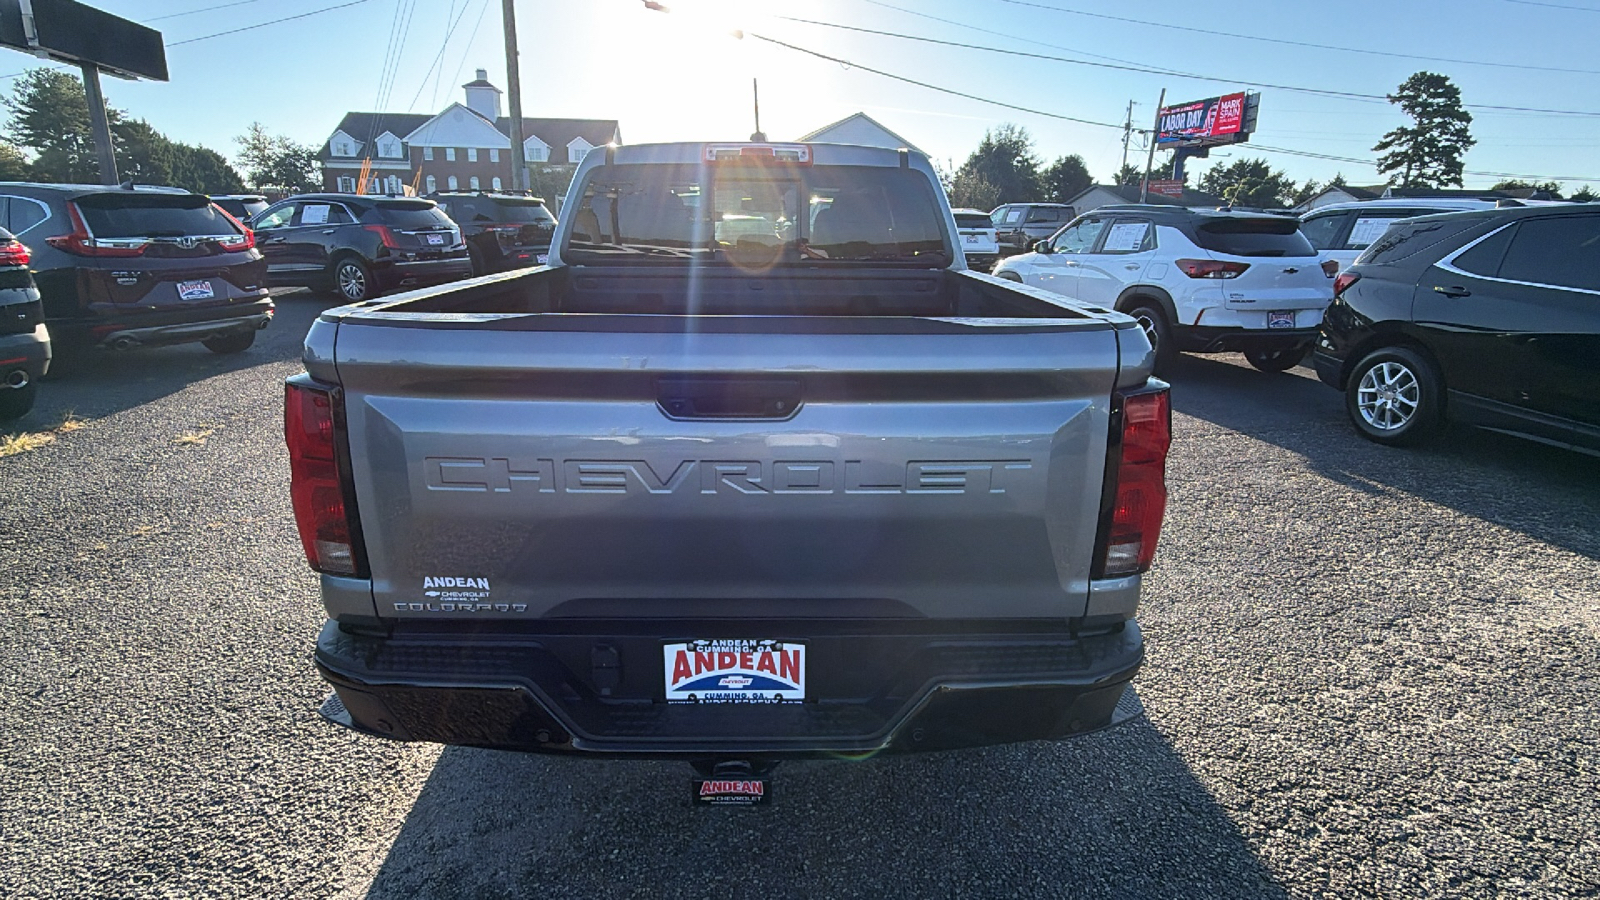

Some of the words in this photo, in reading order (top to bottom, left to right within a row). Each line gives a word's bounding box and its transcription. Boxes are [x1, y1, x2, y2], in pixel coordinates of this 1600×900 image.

[1221, 98, 1242, 109] MARK
[1220, 107, 1240, 118] SPAIN
[1161, 113, 1186, 132] LABOR
[1187, 110, 1203, 127] DAY
[180, 282, 211, 294] ANDEAN
[424, 456, 1032, 496] CHEVROLET
[423, 576, 490, 590] ANDEAN
[393, 602, 528, 613] COLORADO
[711, 639, 757, 647] ANDEAN
[671, 649, 801, 686] ANDEAN
[700, 781, 764, 796] ANDEAN
